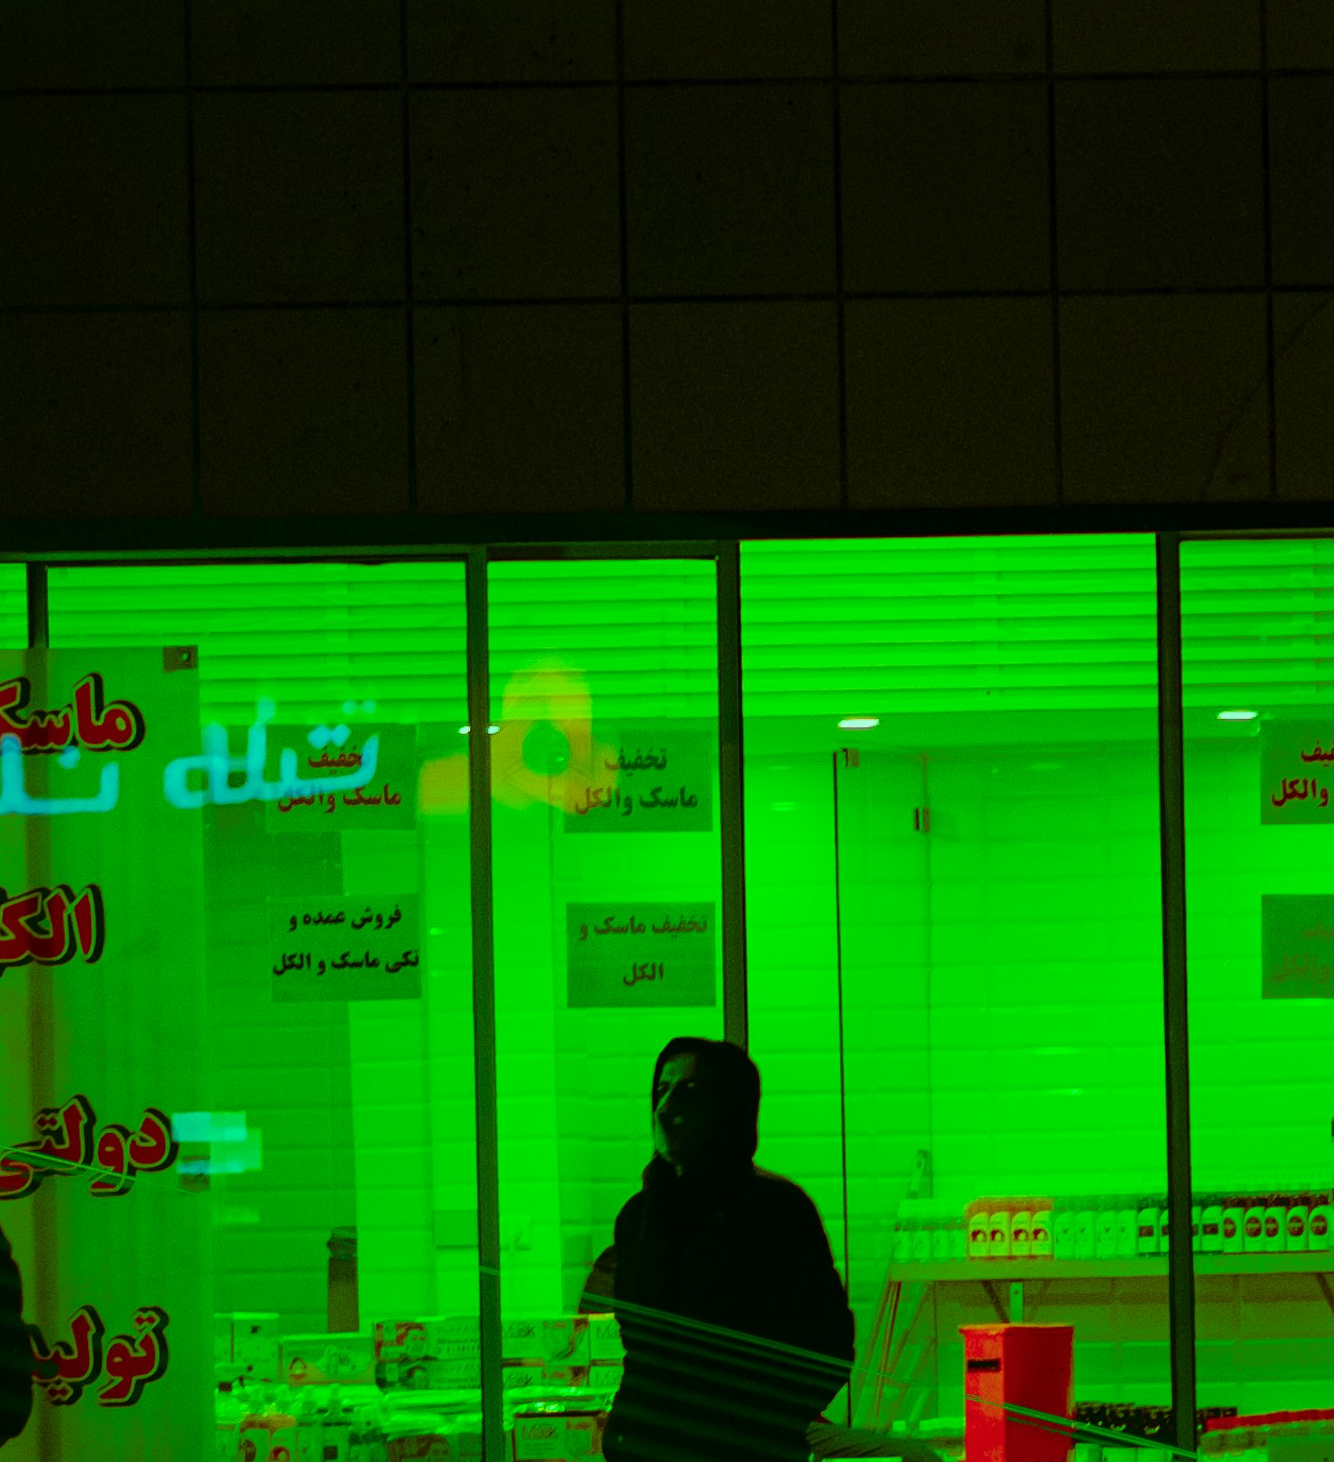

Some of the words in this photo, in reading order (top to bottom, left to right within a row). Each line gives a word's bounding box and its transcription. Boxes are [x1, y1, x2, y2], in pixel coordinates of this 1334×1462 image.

[604, 748, 667, 776] تخفیف
[343, 783, 401, 805] ماسک
[640, 786, 698, 808] ماسک
[287, 915, 297, 932] و
[303, 912, 345, 926] عمده
[351, 904, 402, 929] فروش
[594, 915, 646, 934] ماسک
[651, 914, 708, 939] تخفیف
[579, 923, 588, 942] و
[273, 952, 312, 976] الکل
[317, 959, 326, 976] و
[331, 950, 380, 969] ماسک
[385, 949, 419, 973] تکی
[623, 962, 664, 987] الکل
